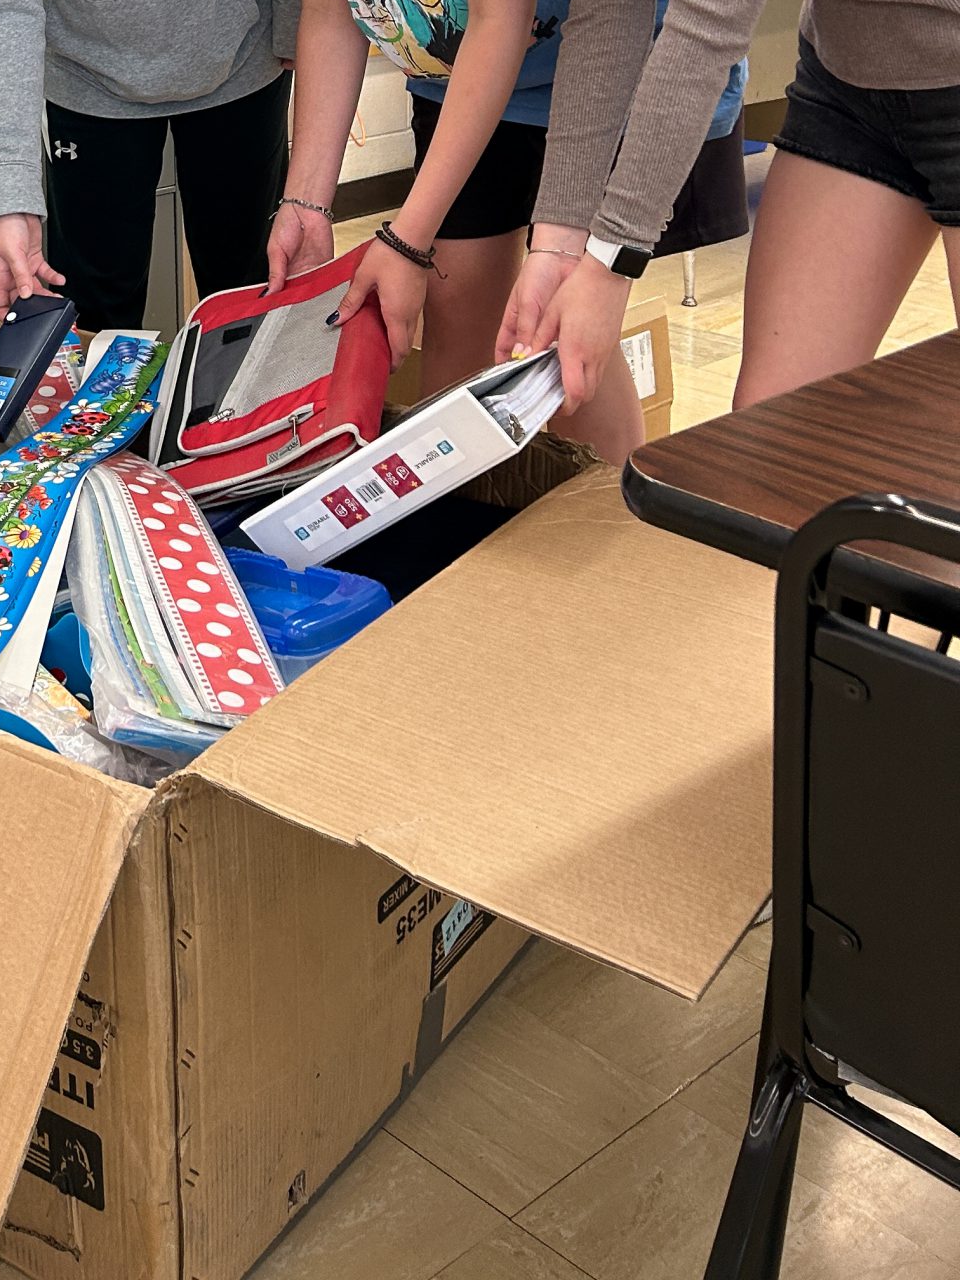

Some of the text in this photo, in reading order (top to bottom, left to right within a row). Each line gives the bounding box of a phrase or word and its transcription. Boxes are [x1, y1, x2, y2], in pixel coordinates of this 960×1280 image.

[307, 514, 330, 530] DURABLE
[383, 881, 409, 912] MIXER
[396, 888, 444, 945] ME35
[445, 903, 468, 942] 0412
[73, 1039, 94, 1060] 3.5
